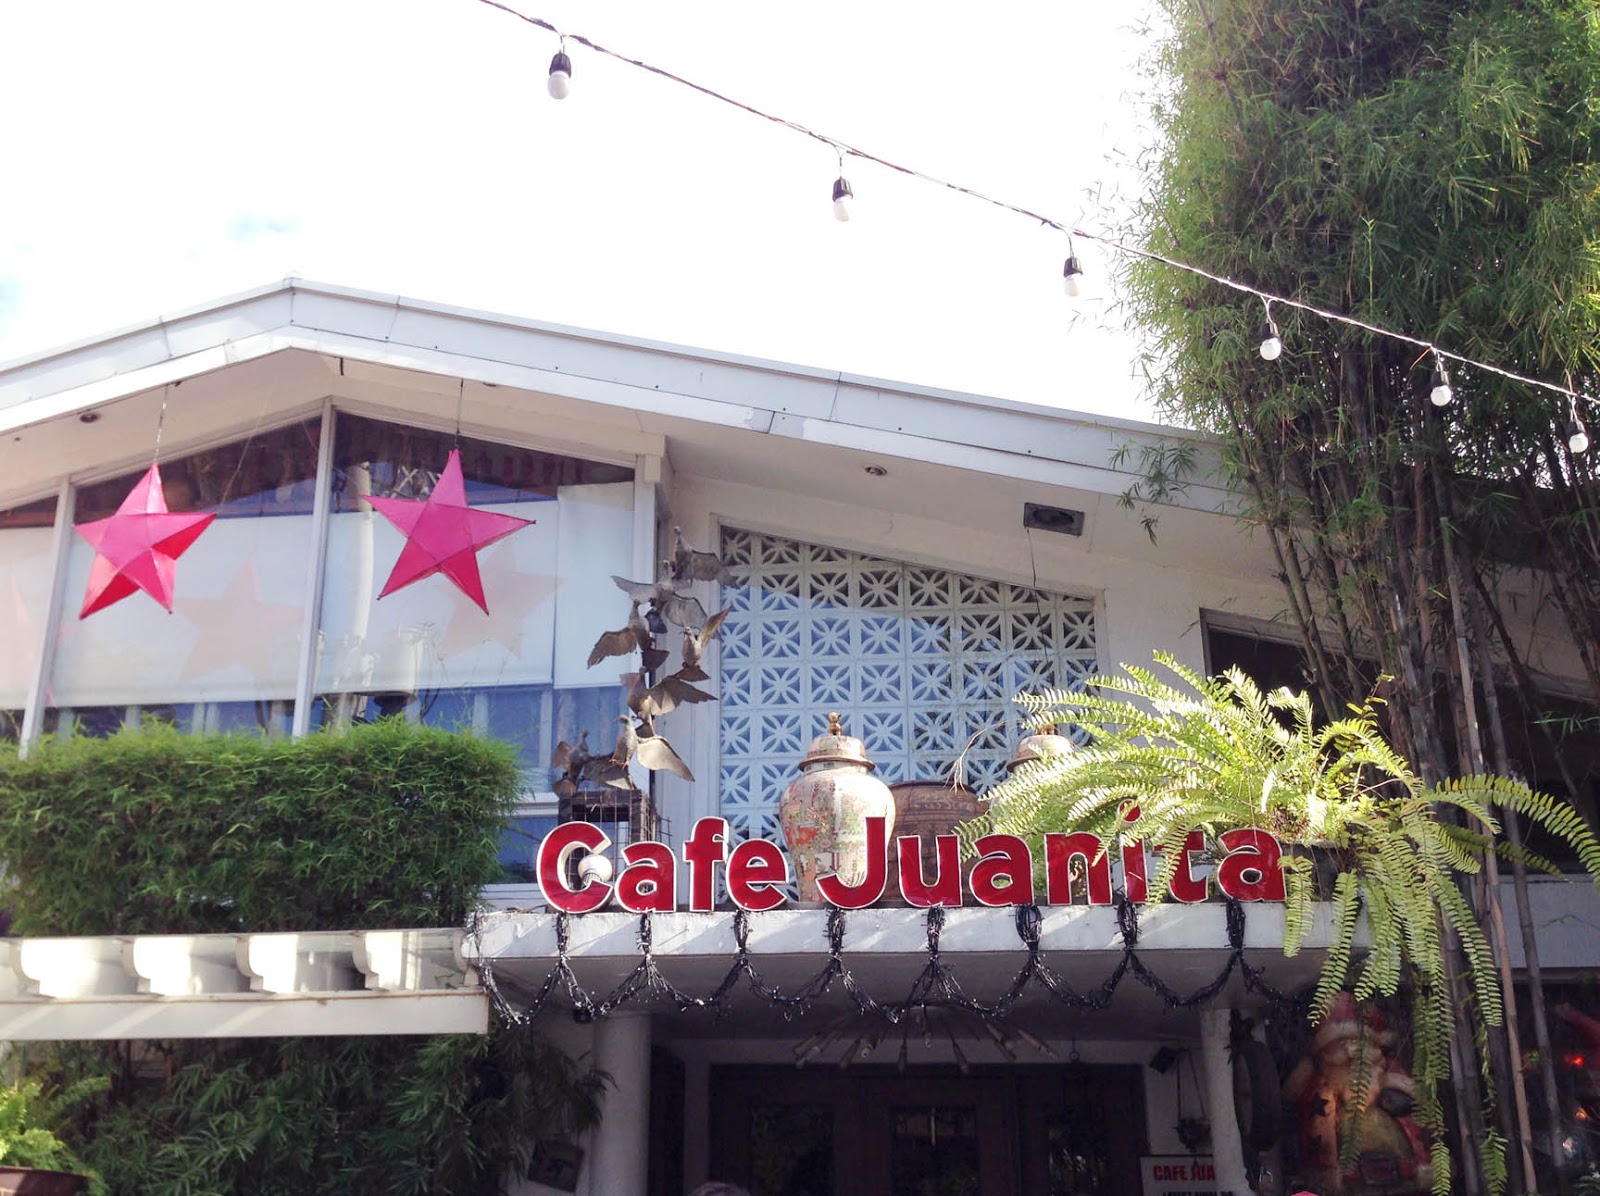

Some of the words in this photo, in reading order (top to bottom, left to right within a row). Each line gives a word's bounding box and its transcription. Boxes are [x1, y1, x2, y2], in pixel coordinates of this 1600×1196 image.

[536, 816, 789, 914] Cafe
[815, 798, 1287, 909] Juanita
[1153, 1165, 1187, 1181] CAFE
